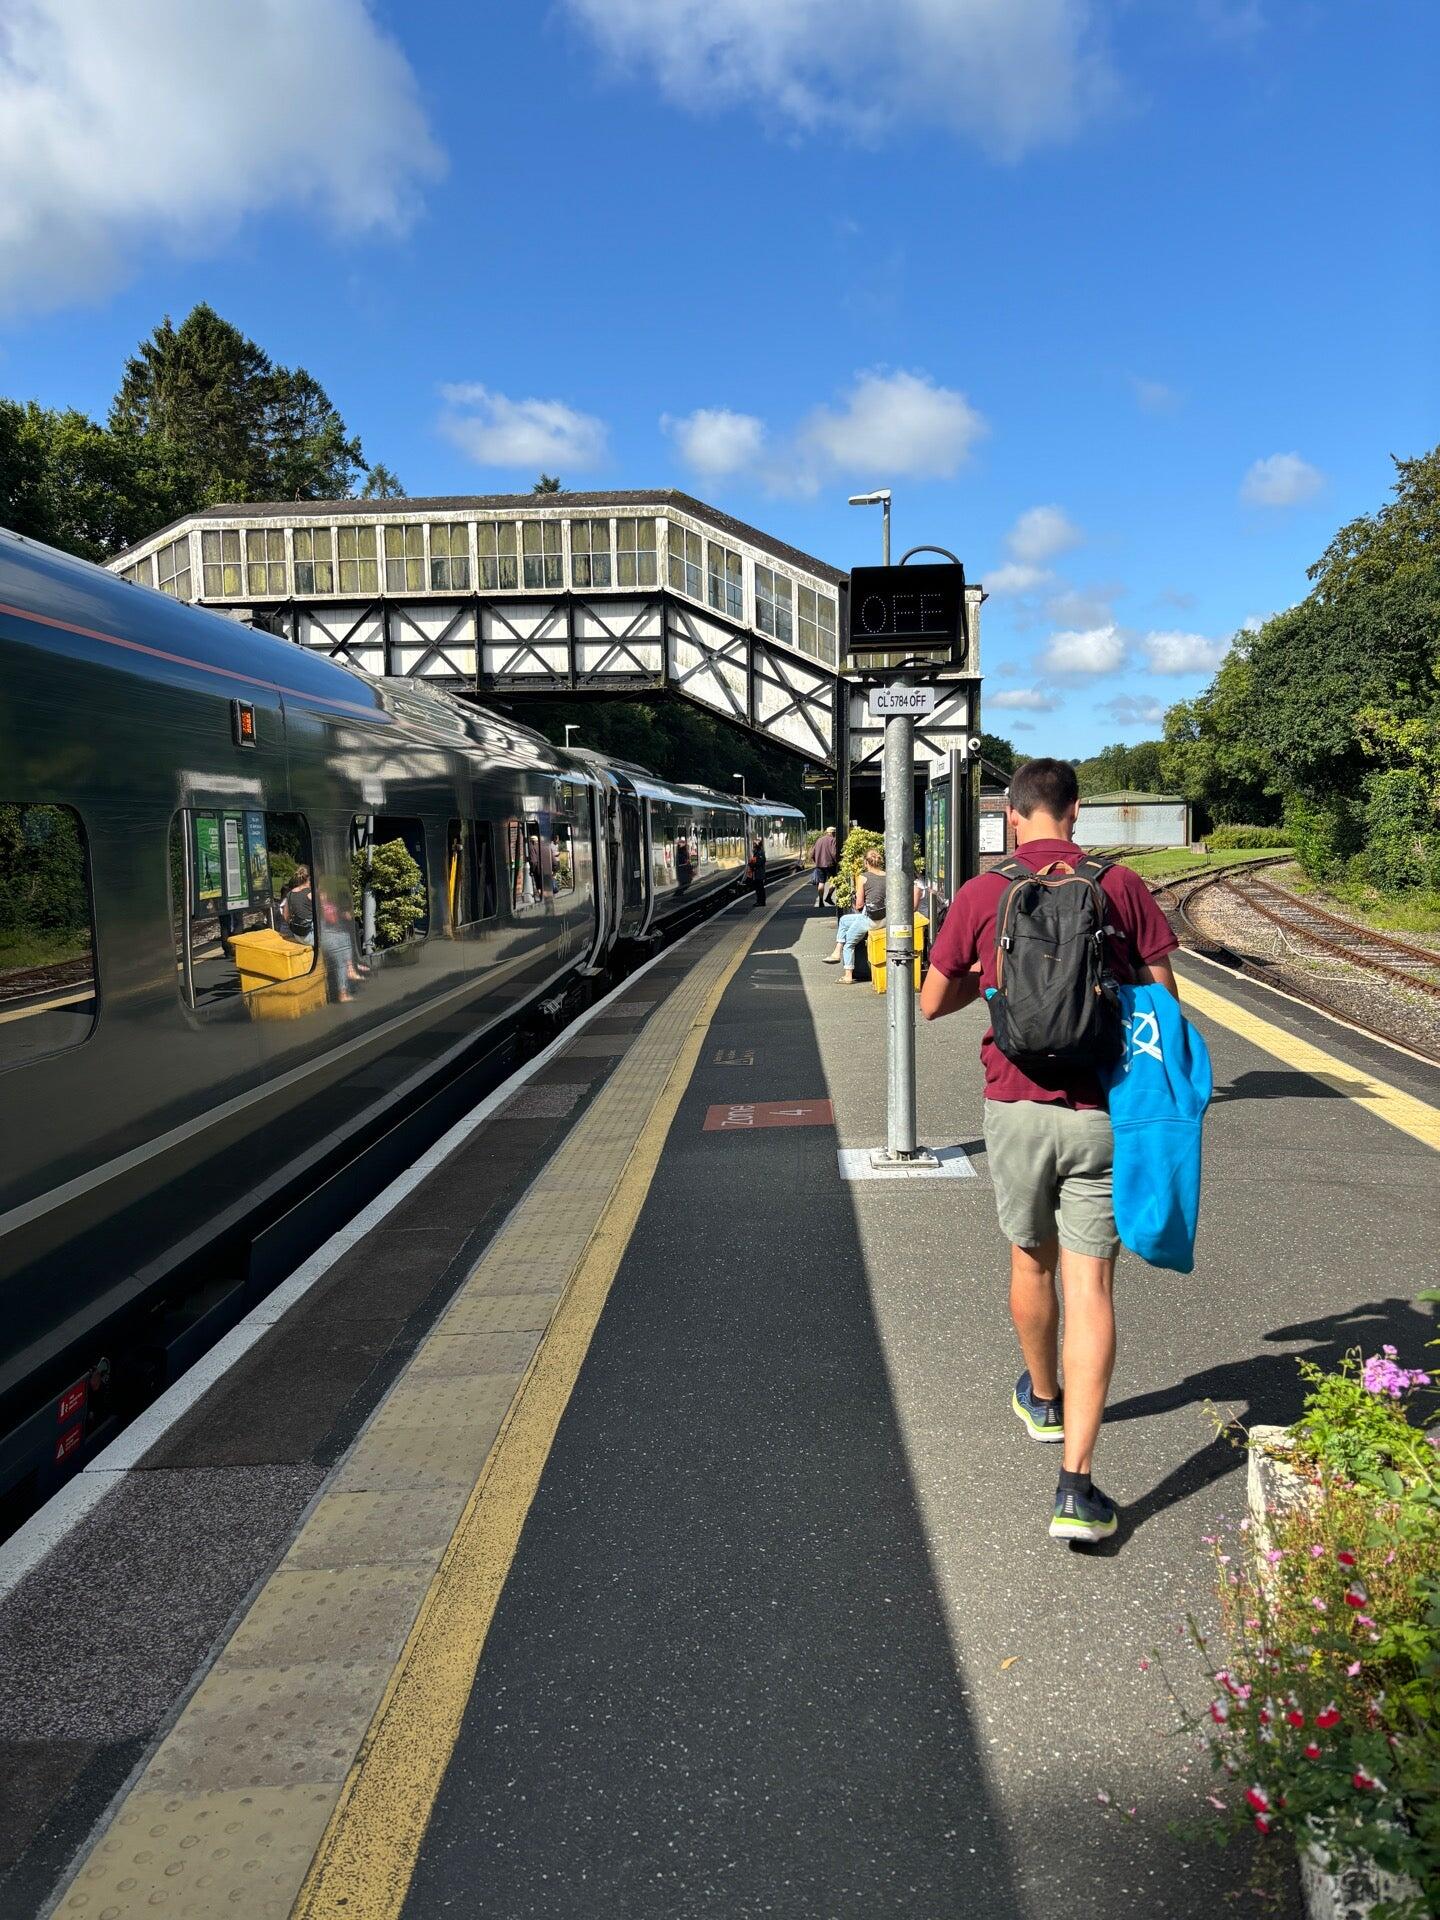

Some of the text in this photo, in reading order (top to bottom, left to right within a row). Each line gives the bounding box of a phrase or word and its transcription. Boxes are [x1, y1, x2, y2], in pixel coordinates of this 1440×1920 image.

[861, 593, 943, 634] OFF
[877, 694, 927, 708] CL 5784 OFF
[720, 1104, 756, 1127] Zone
[768, 1108, 814, 1117] 4
